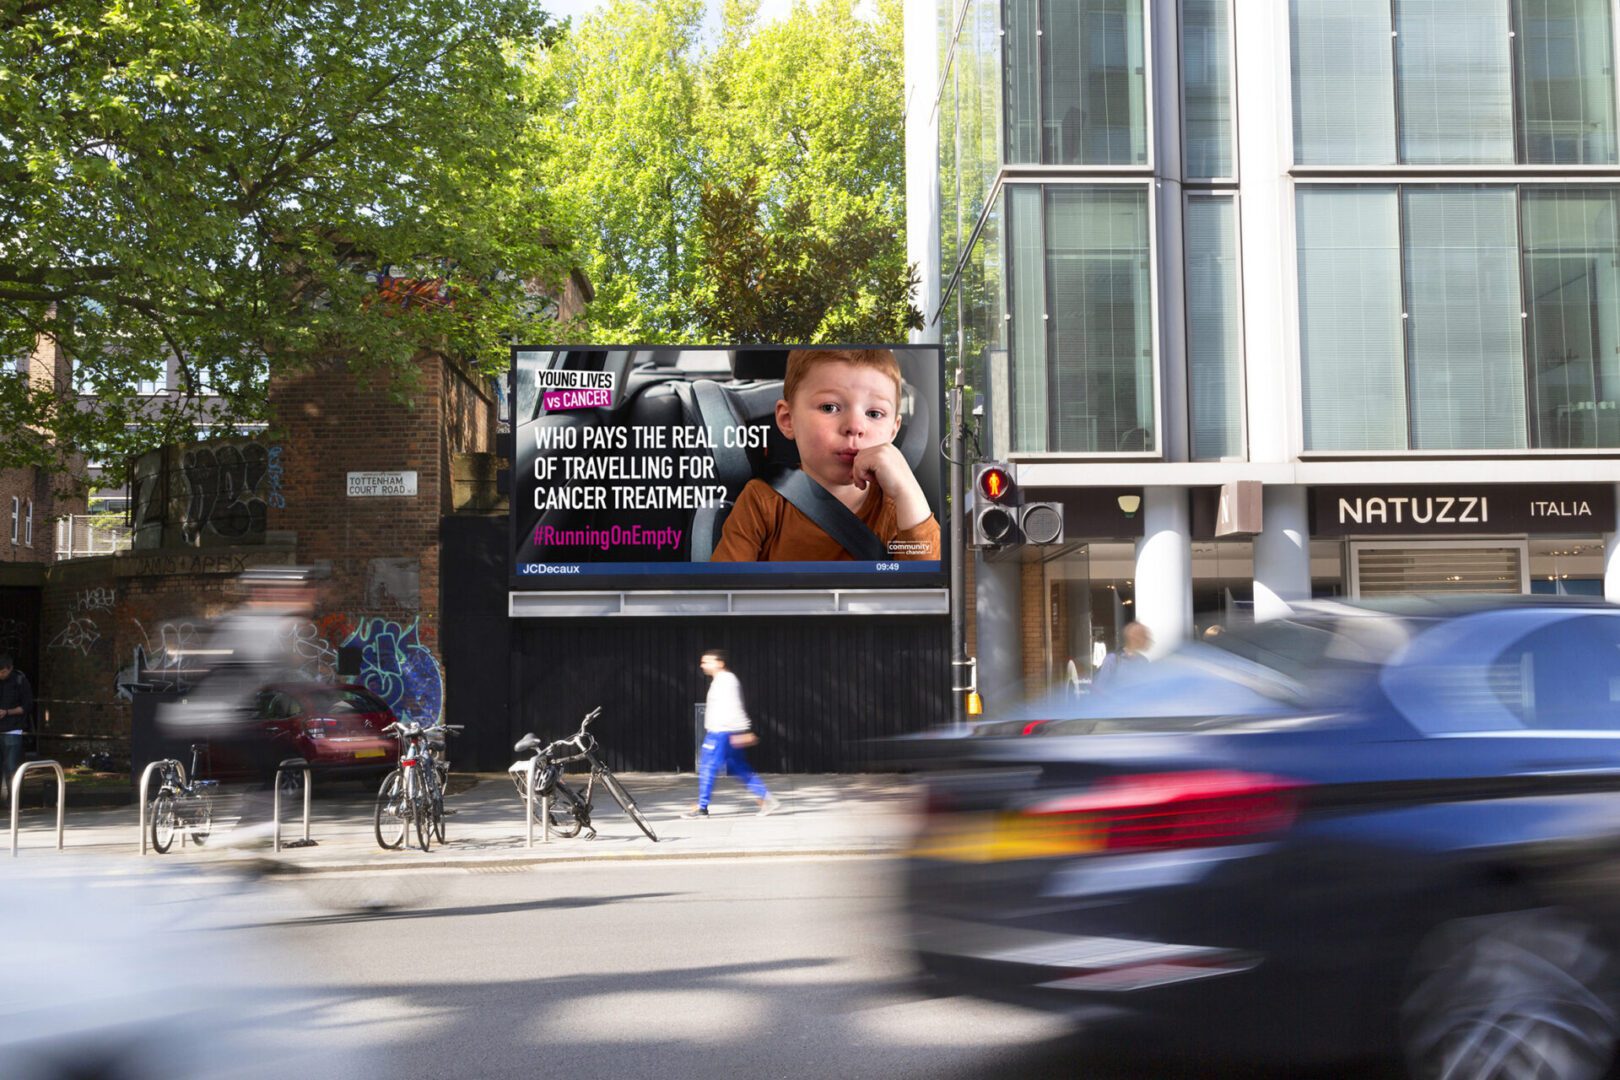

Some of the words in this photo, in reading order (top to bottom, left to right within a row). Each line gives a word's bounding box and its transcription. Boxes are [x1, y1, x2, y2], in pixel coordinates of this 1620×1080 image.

[538, 371, 577, 387] YOUNG
[580, 372, 612, 389] LIVES
[562, 390, 609, 408] CANCER
[534, 426, 577, 450] WHO
[583, 426, 628, 449] PAYS
[632, 425, 666, 449] THE
[672, 425, 718, 449] REAL
[723, 425, 771, 449] COST
[534, 456, 558, 480] OF
[562, 456, 673, 480] TRAVELLING
[679, 456, 715, 479] FOR
[349, 477, 403, 485] TOTTENHAM
[349, 485, 378, 495] COURT
[381, 485, 406, 494] ROAD
[534, 486, 607, 510] CANCER
[611, 485, 728, 510] TREATMENT?
[1338, 496, 1489, 524] NATUZZI
[1530, 501, 1593, 517] ITALIA
[533, 525, 682, 550] #RunningOnEmpty
[522, 564, 580, 574] JCDecaux
[876, 563, 900, 571] 09:49
